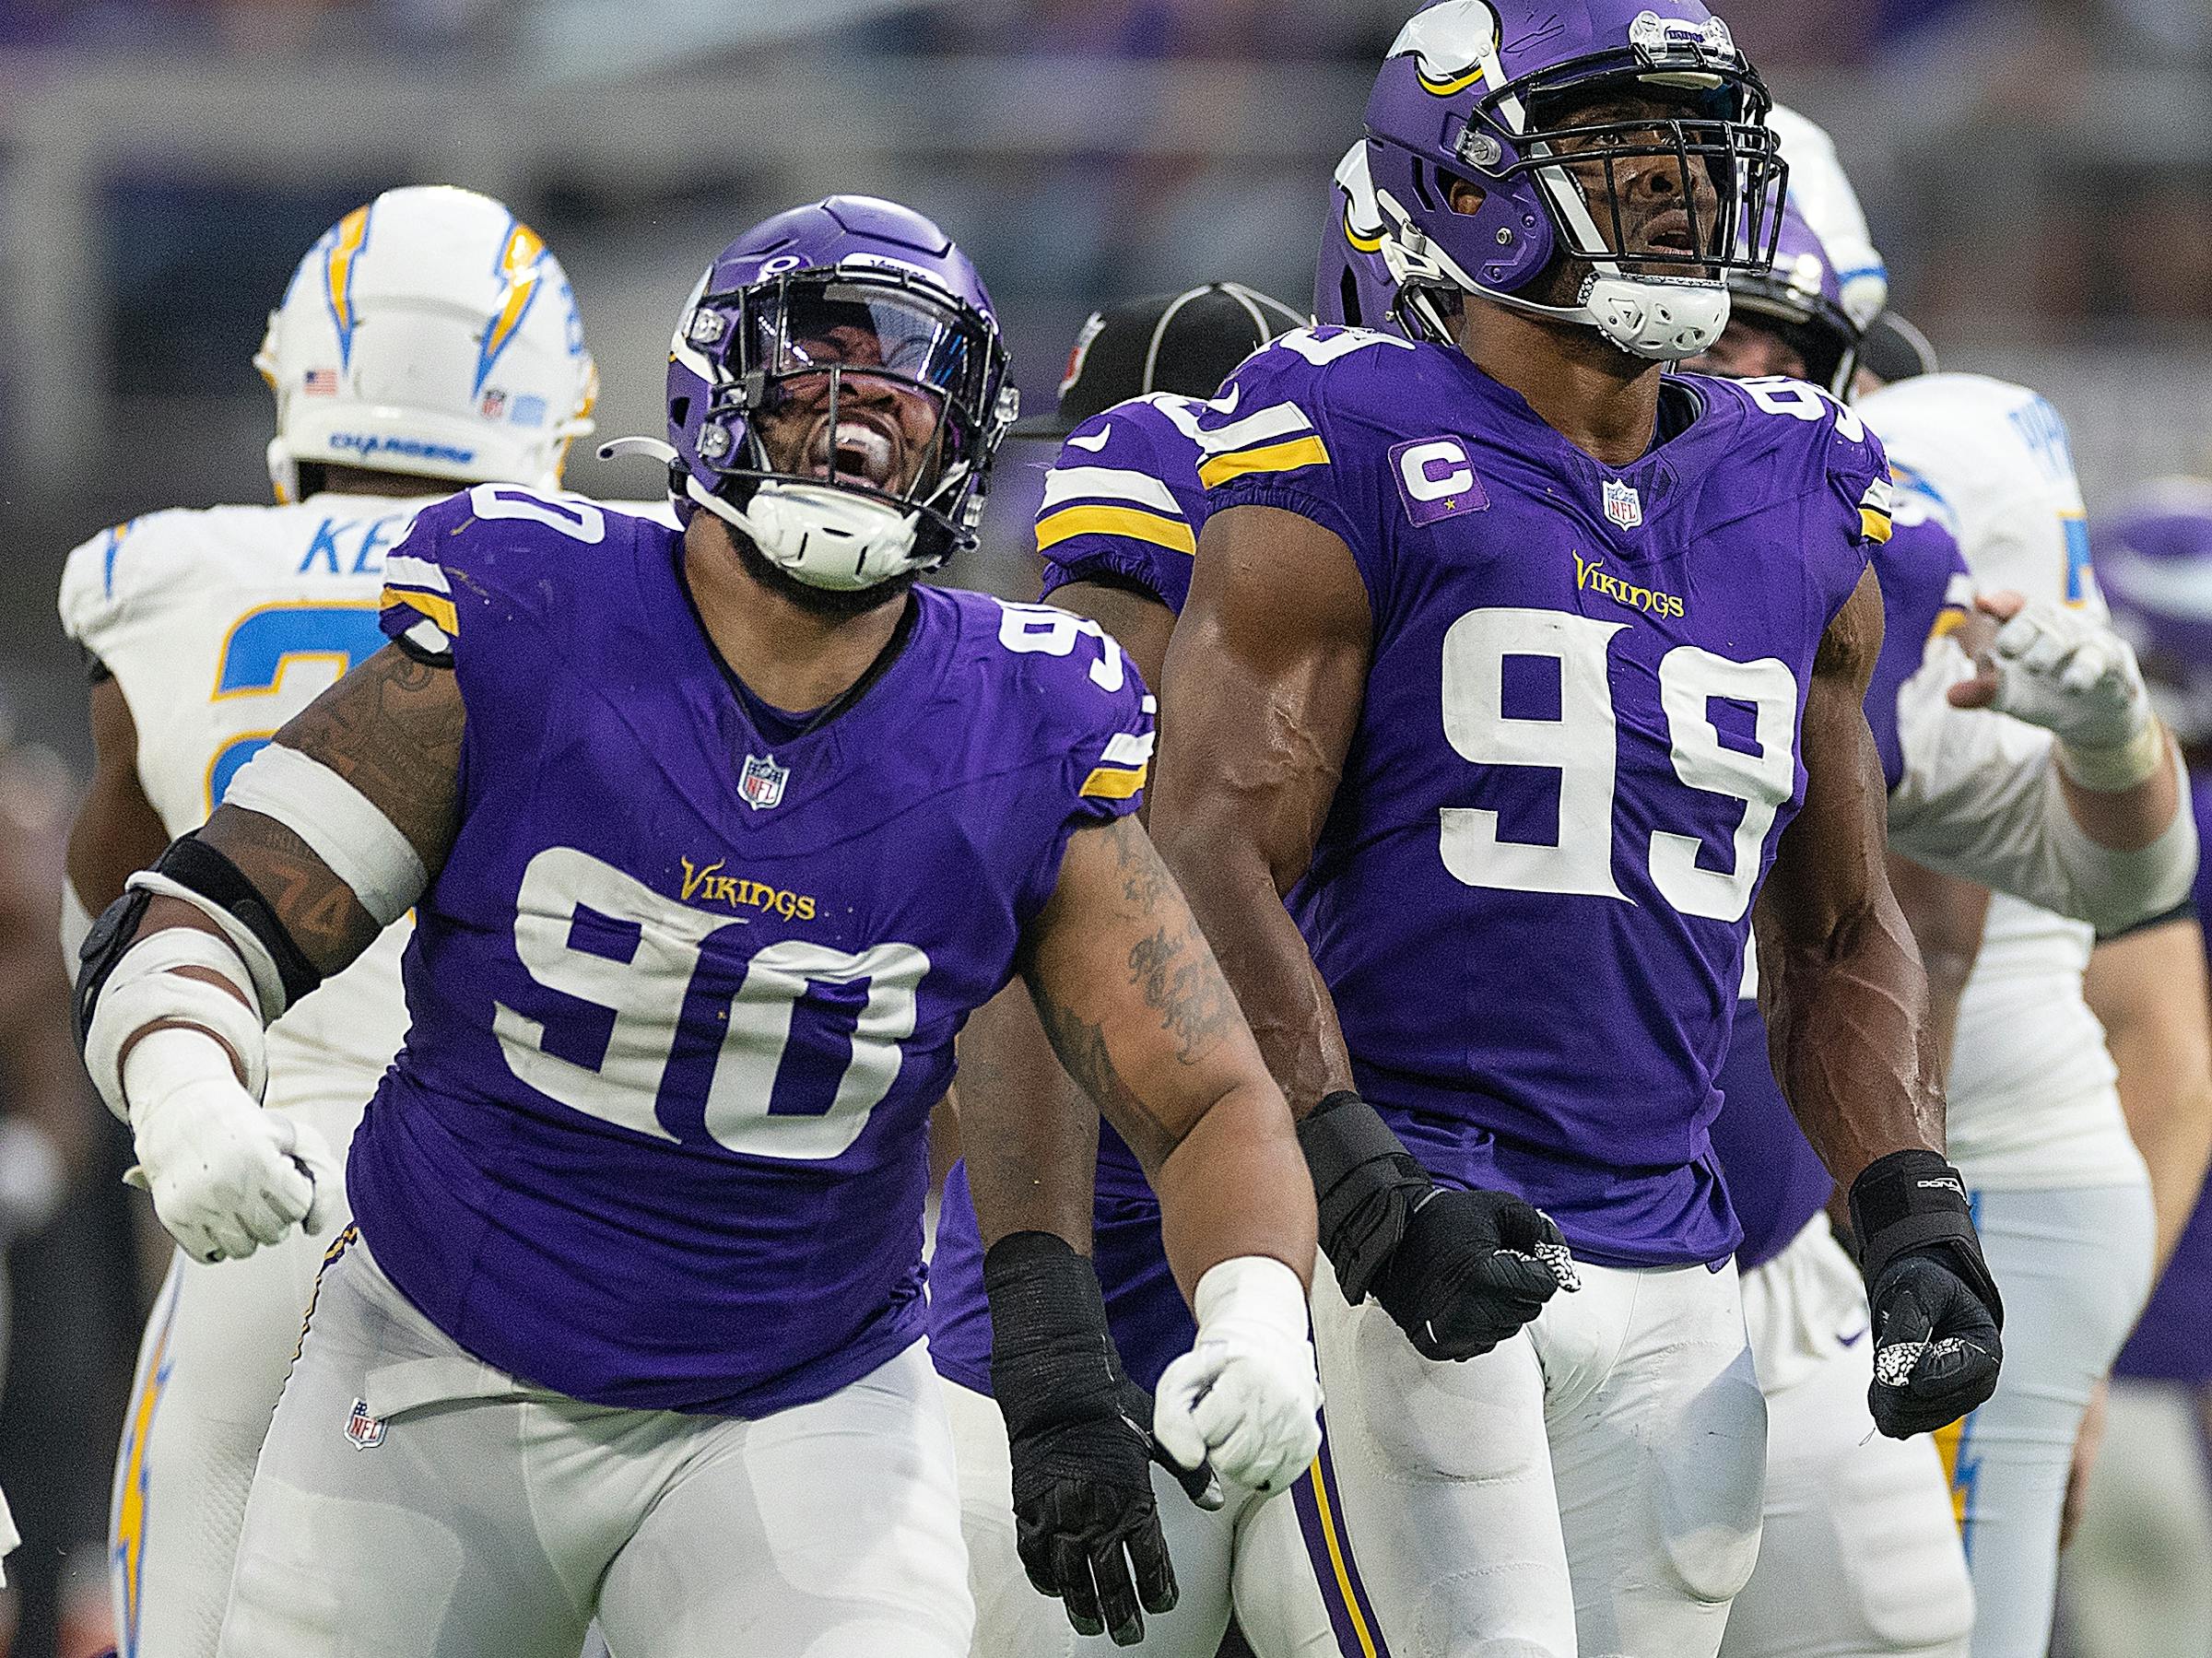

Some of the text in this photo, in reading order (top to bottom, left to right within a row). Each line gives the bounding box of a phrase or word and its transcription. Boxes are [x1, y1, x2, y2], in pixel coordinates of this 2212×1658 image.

[1399, 441, 1474, 500] C
[1610, 500, 1636, 521] NFL
[1440, 607, 1798, 923] 99
[747, 776, 774, 801] NFL
[492, 846, 931, 1159] 90
[350, 1417, 377, 1440] NFL
